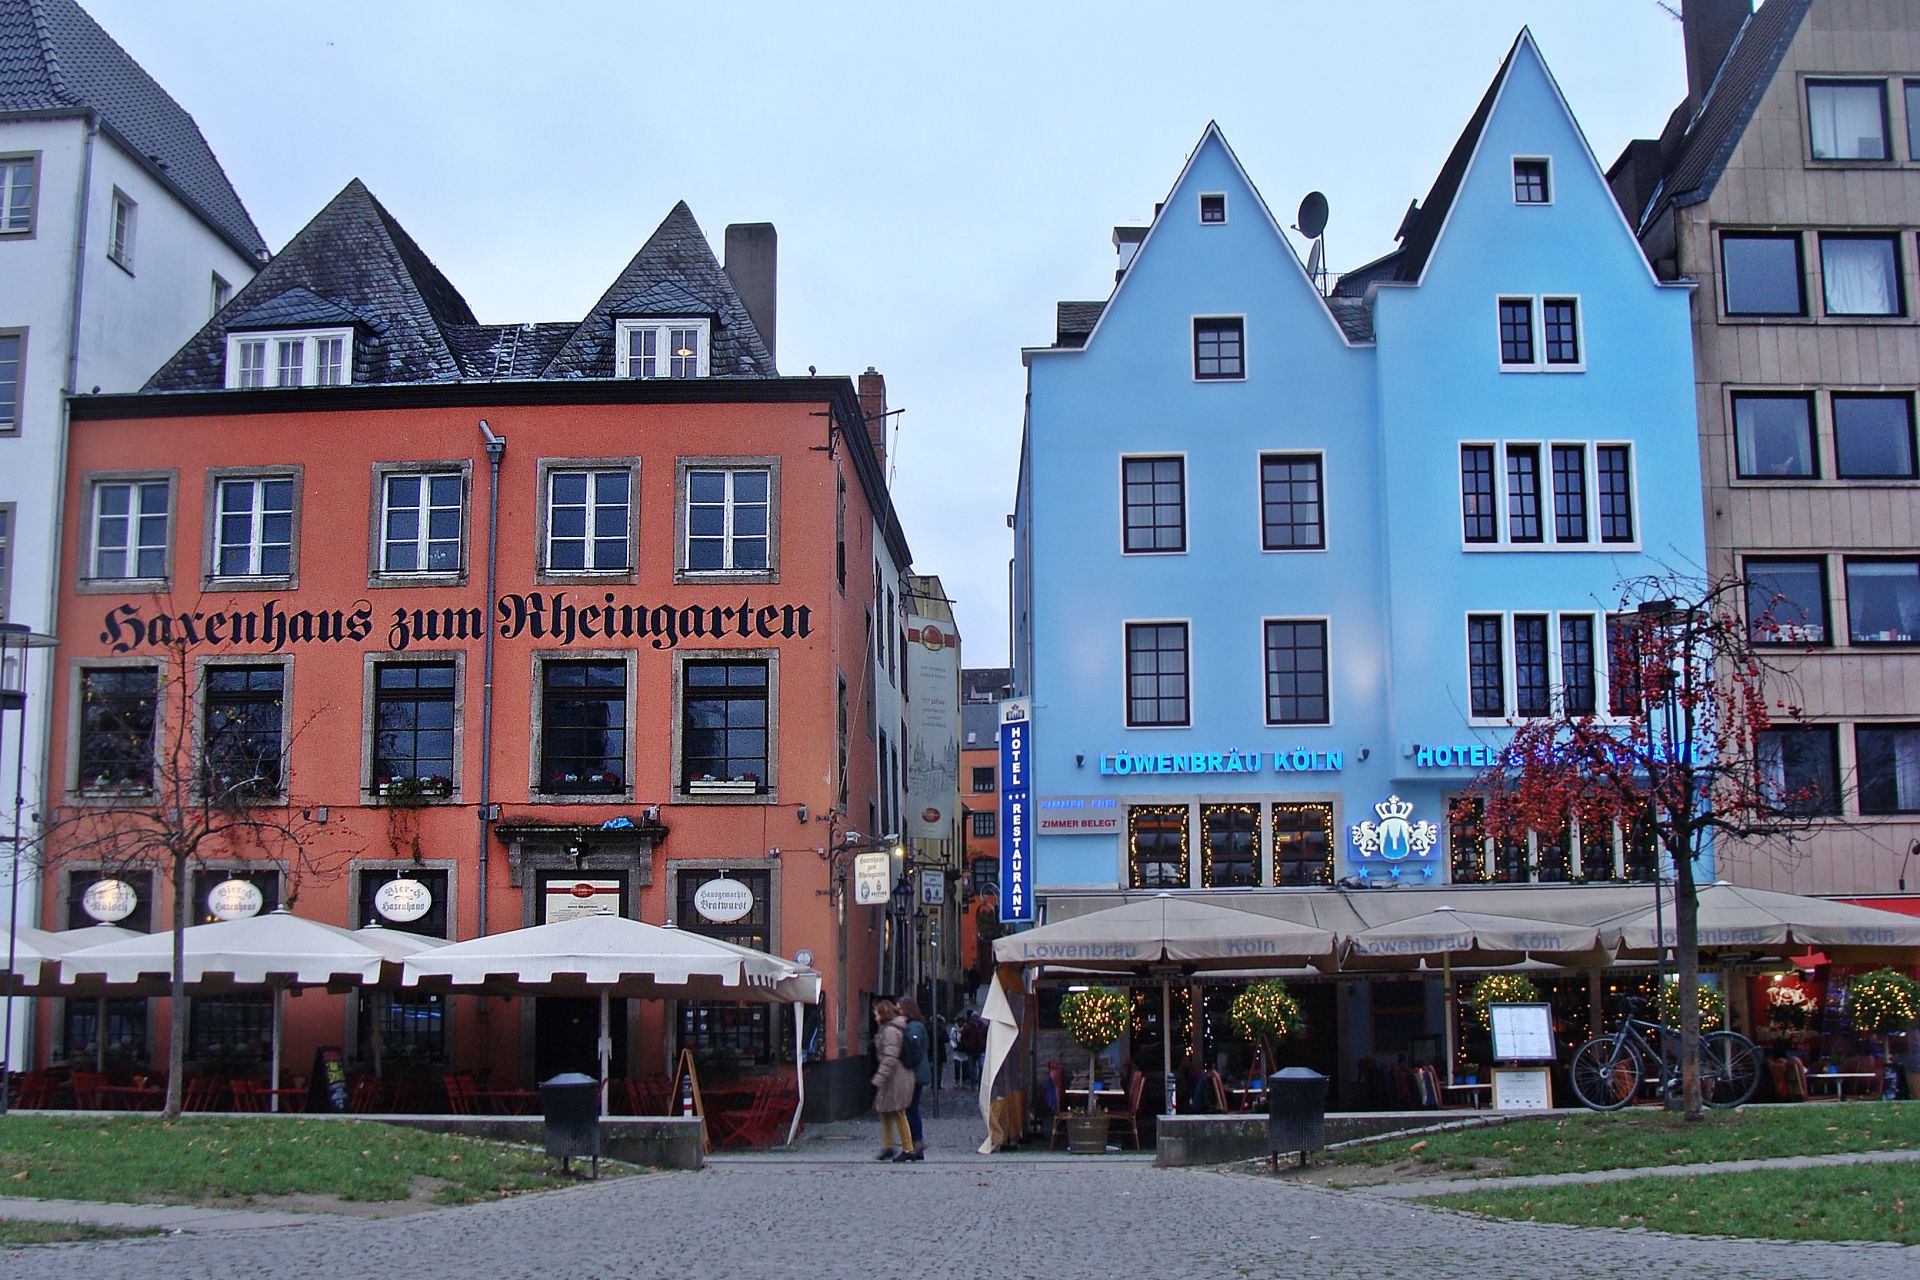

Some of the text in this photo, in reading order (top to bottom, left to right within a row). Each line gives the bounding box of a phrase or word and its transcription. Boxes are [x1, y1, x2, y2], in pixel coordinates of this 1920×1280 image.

[100, 592, 815, 655] Haxenhaus zum Rheingarten
[1011, 727, 1021, 785] HOTEL
[1100, 746, 1344, 775] LÖWENBRÄU KÖLN
[1416, 745, 1499, 767] HOTEL
[1042, 819, 1117, 828] ZIMMER BELEGT
[1012, 803, 1022, 918] RESTAURANT
[700, 889, 747, 900] Hausgemachte
[700, 899, 747, 910] Bratwurst
[1356, 934, 1561, 953] Löwenbräu Köln
[1650, 927, 1896, 945] Löenbräu Köln
[1024, 938, 1275, 959] Löwenbräu Köln
